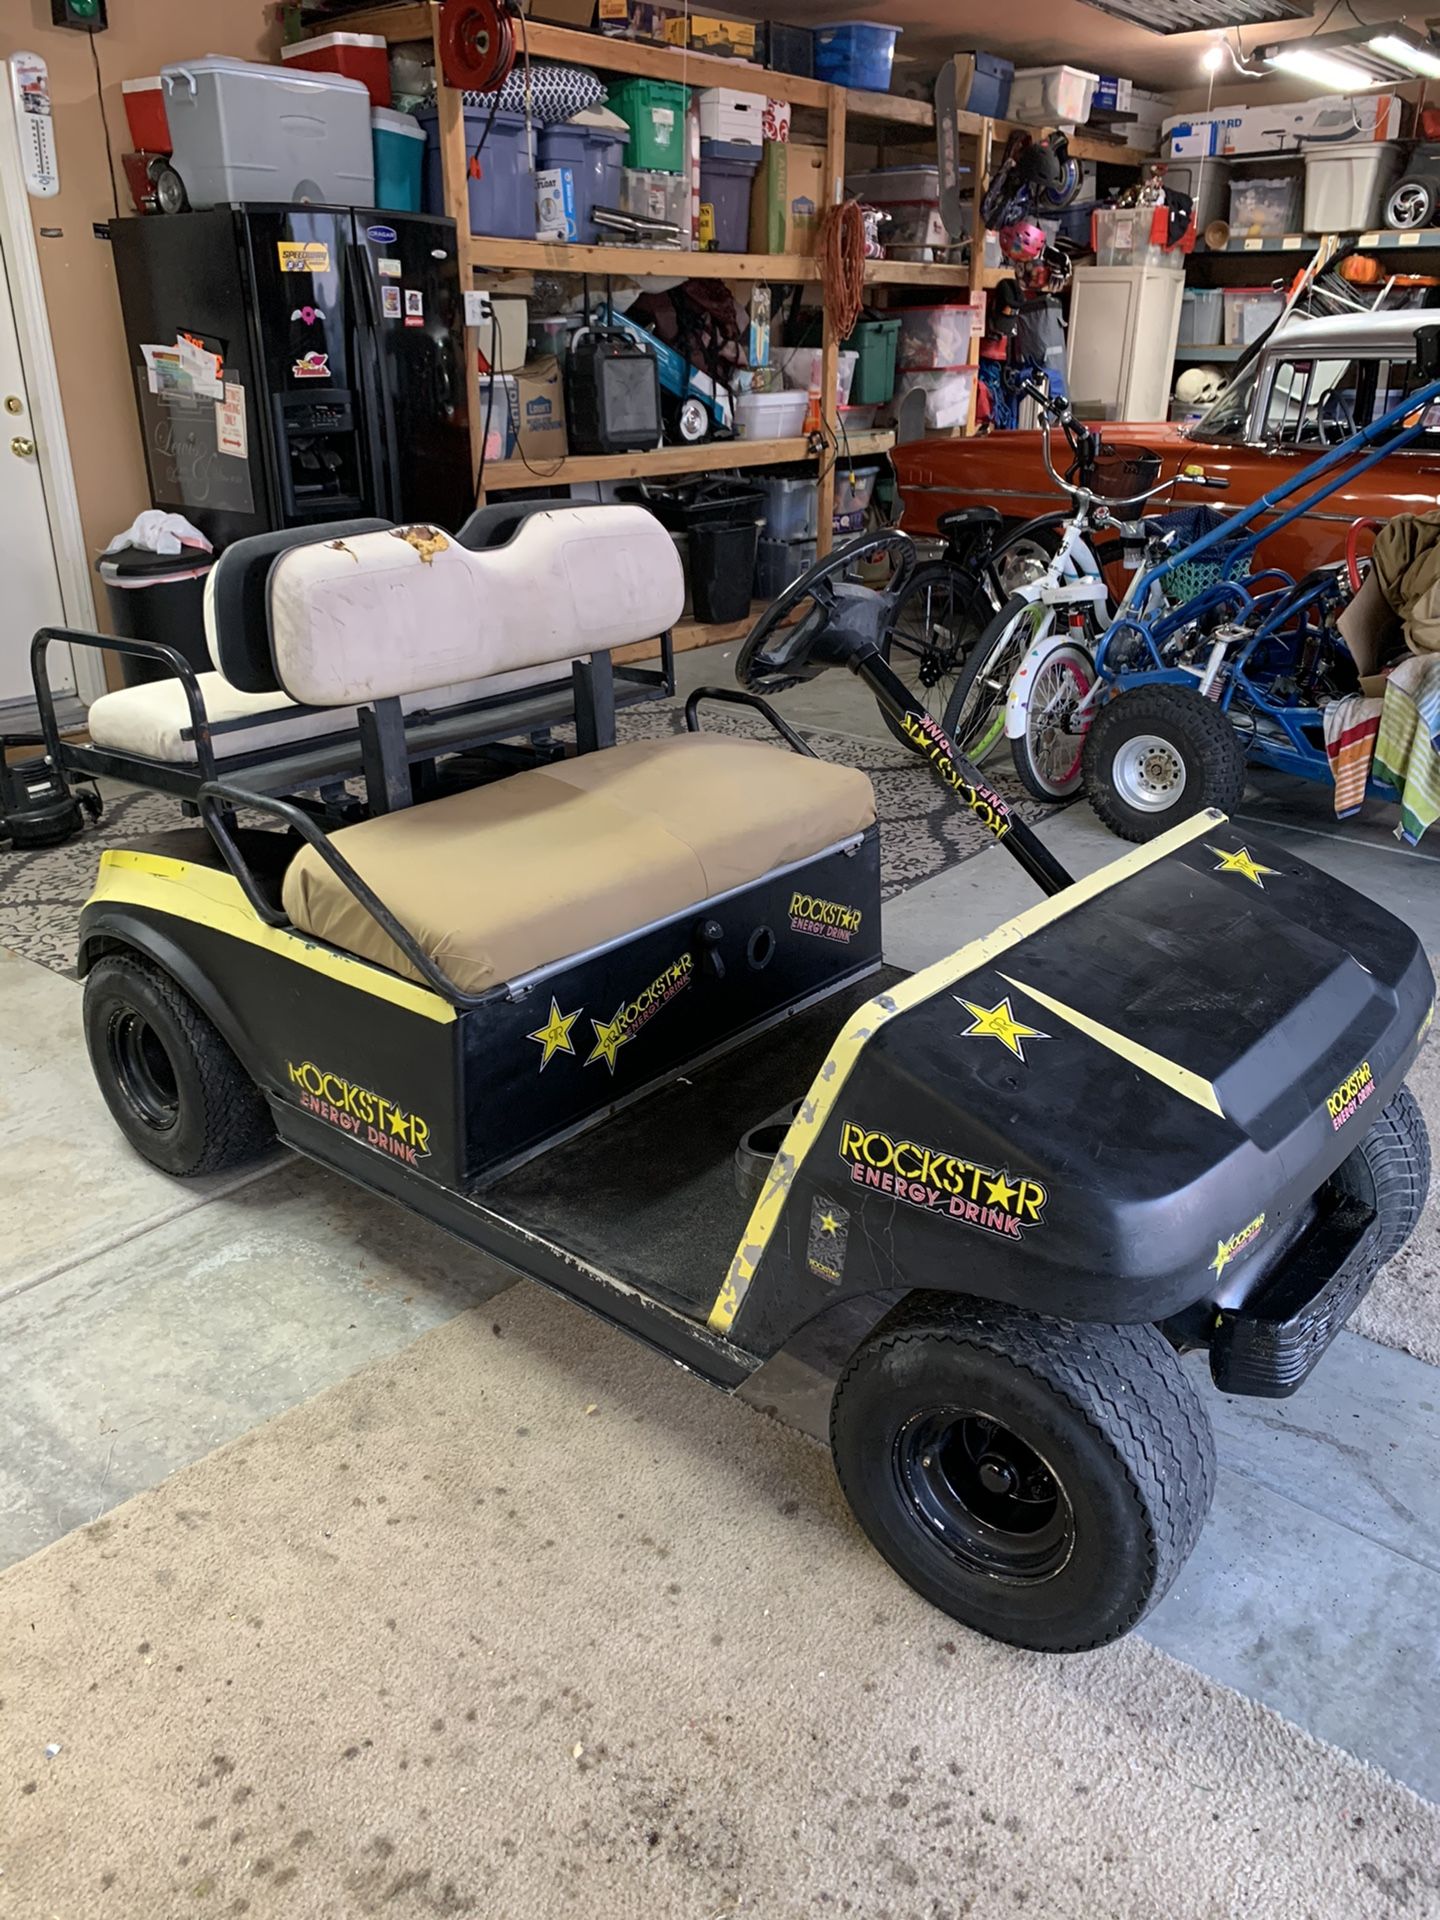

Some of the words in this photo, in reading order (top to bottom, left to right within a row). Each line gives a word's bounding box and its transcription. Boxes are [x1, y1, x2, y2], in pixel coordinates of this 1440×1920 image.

[789, 893, 861, 931] ROCKSTAR
[792, 917, 826, 934] ENERGY
[826, 925, 851, 941] DRINK
[615, 953, 693, 1034] ROCKSTAR
[626, 999, 662, 1037] ENERGY
[663, 974, 691, 1001] DRINK
[287, 1061, 429, 1152] ROCKSTAR
[1326, 1061, 1373, 1118] ROCKSTAR
[1332, 1097, 1358, 1131] ENERGY
[1357, 1078, 1376, 1105] DRINK
[300, 1090, 361, 1134] ENERGY
[366, 1125, 418, 1167] DRINK
[841, 1123, 1046, 1221] ROCKSTAR
[852, 1161, 941, 1207] ENERGY
[949, 1195, 1023, 1236] DRINK
